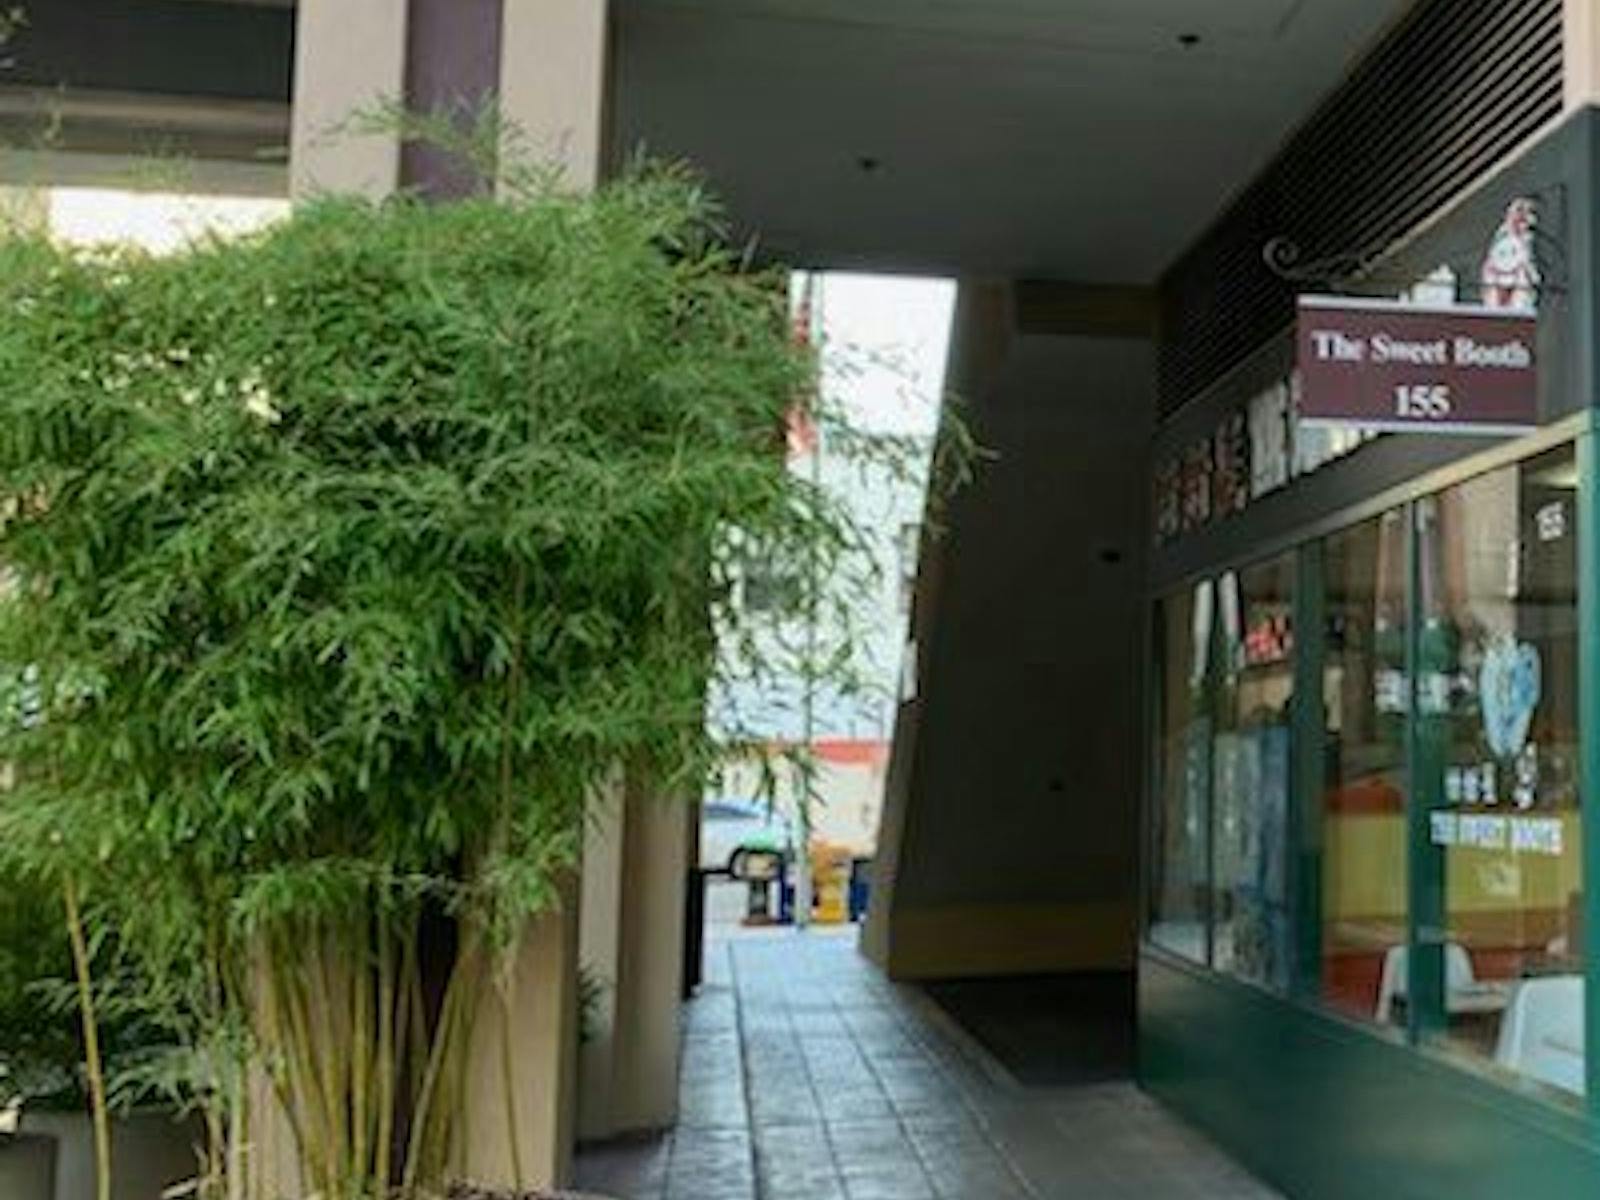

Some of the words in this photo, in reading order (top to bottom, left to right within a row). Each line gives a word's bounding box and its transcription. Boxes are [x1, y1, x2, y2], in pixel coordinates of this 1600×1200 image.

[1310, 329, 1362, 362] The
[1370, 332, 1448, 364] Sweet
[1454, 336, 1531, 368] Booth
[1394, 384, 1451, 418] 155
